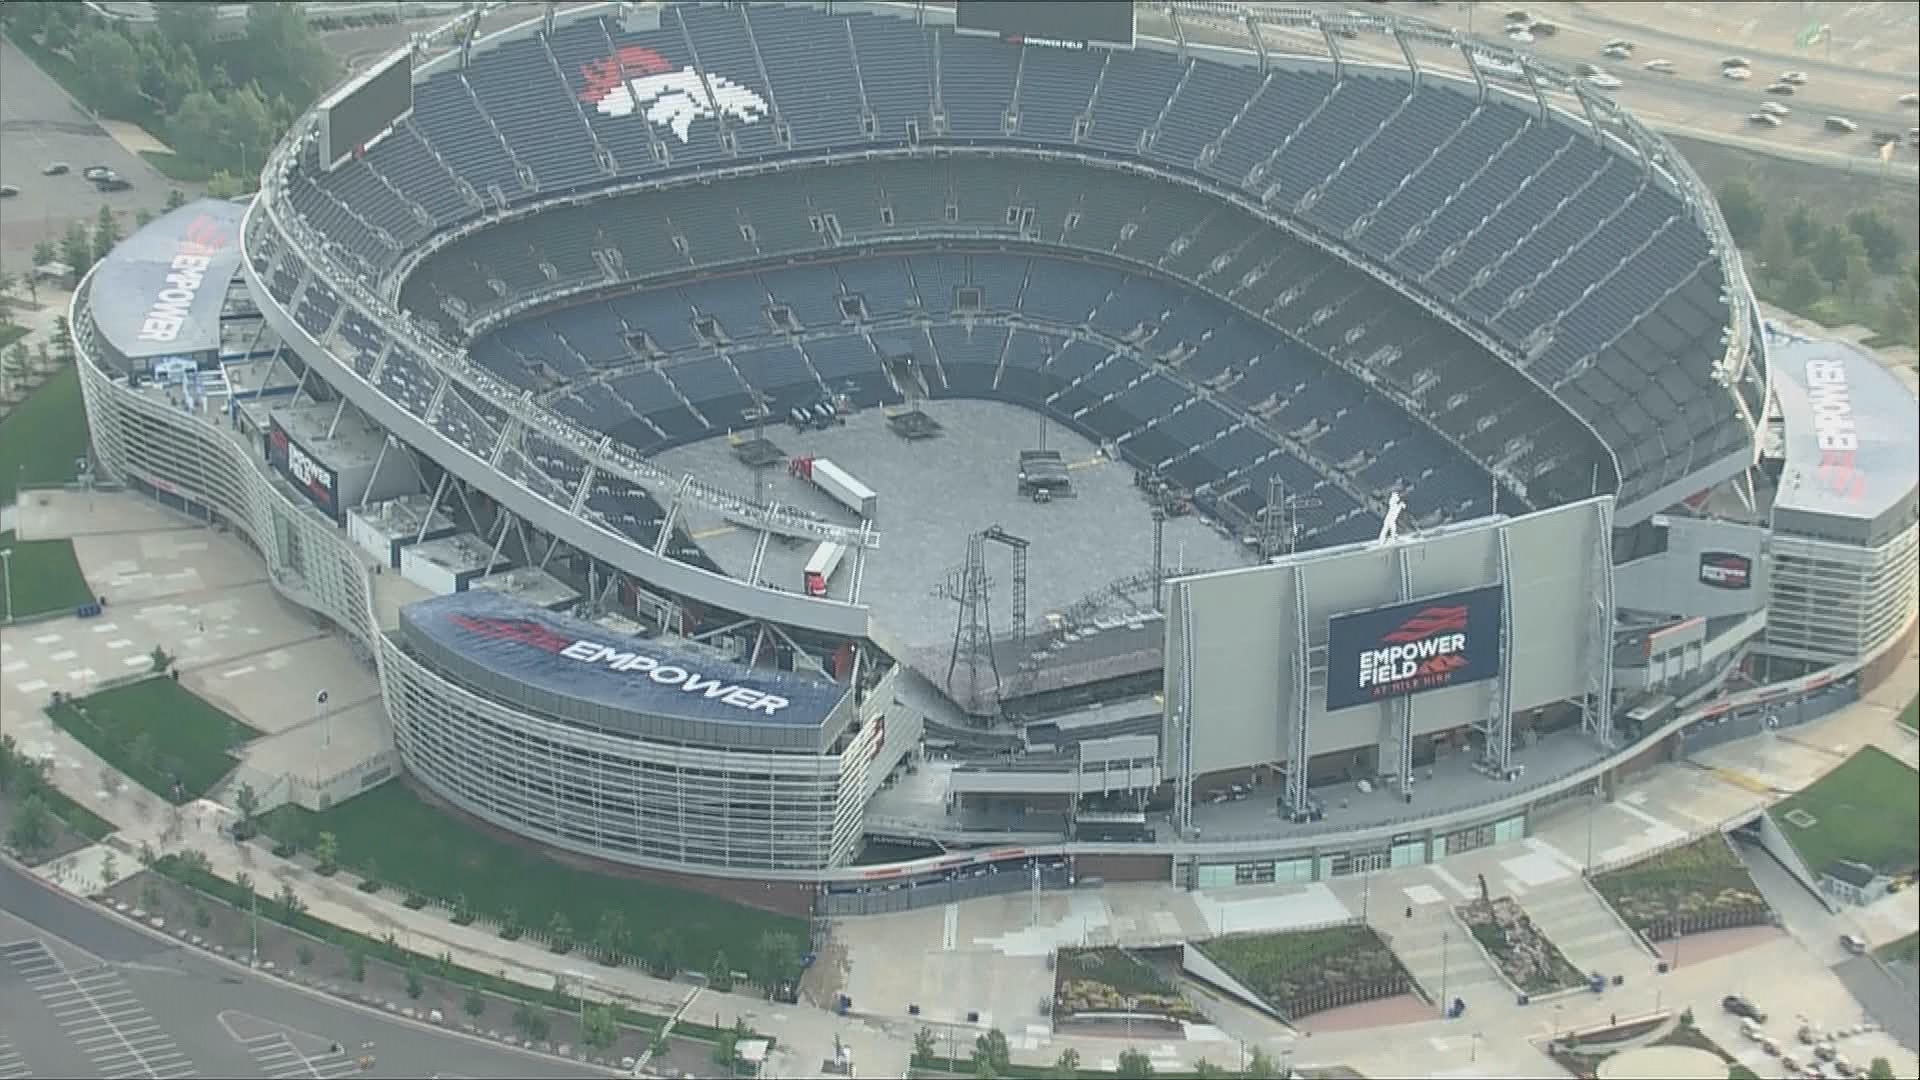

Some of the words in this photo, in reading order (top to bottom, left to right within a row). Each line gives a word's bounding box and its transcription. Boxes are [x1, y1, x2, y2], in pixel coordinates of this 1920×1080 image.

[138, 255, 210, 342] EMPOWER
[1806, 360, 1858, 450] EMPOWER
[560, 640, 790, 715] EMPOWER
[1359, 661, 1418, 688] FIELD
[1360, 633, 1466, 669] EMPOWER
